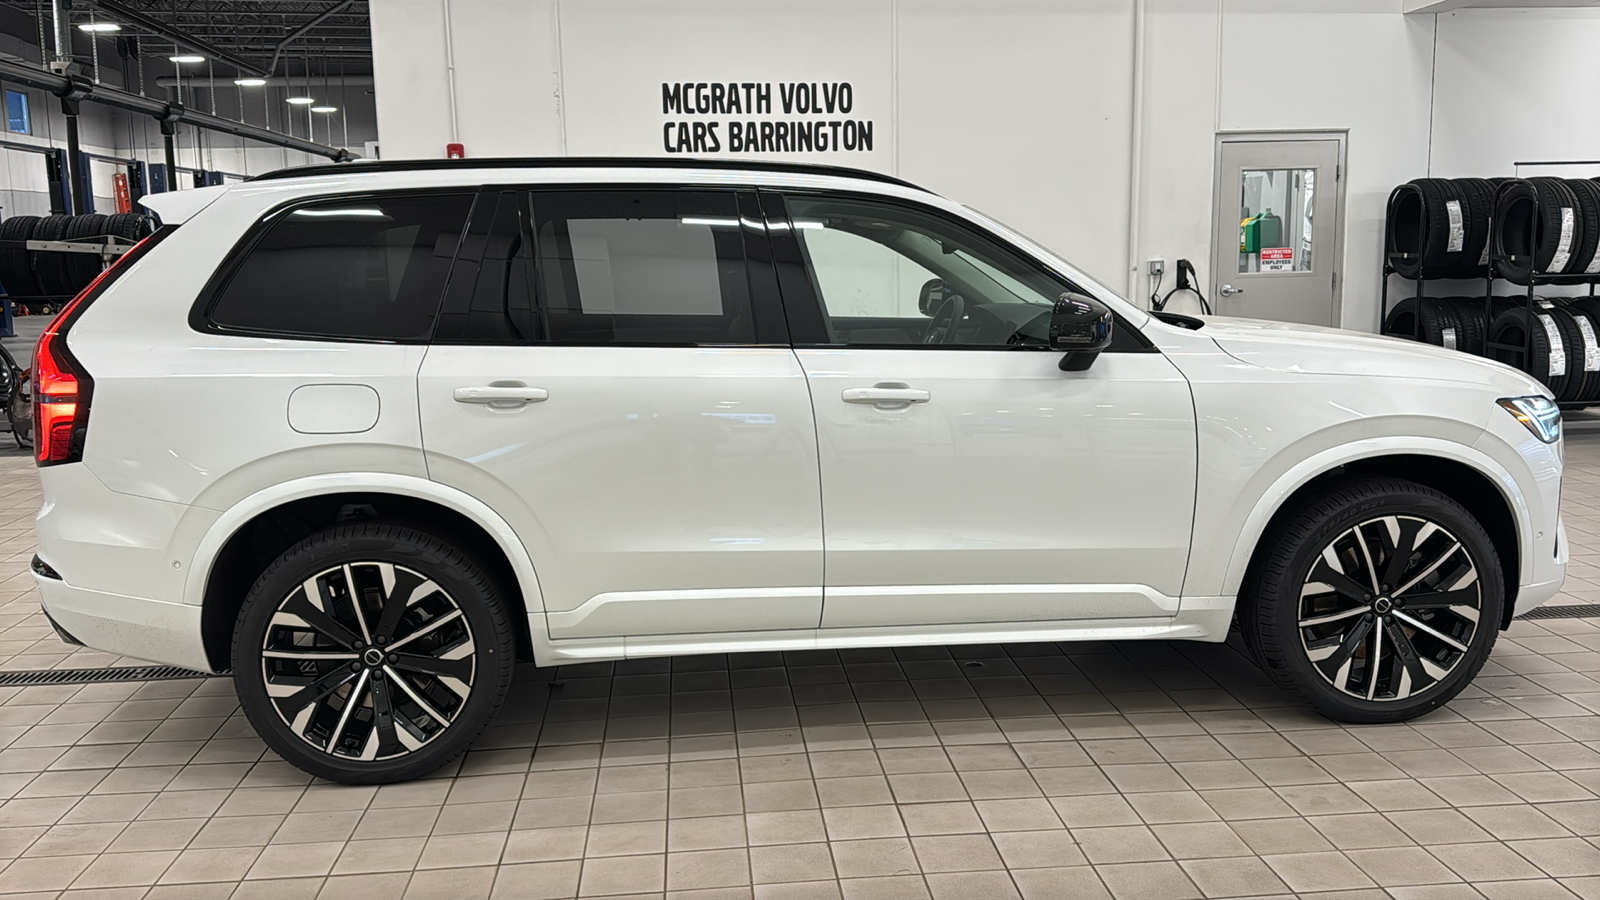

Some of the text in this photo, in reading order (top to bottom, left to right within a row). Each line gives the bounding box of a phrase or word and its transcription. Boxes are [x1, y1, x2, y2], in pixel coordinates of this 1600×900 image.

[662, 82, 853, 114] MCGRATH VOLVO
[663, 120, 873, 153] CARS BARRINGTON
